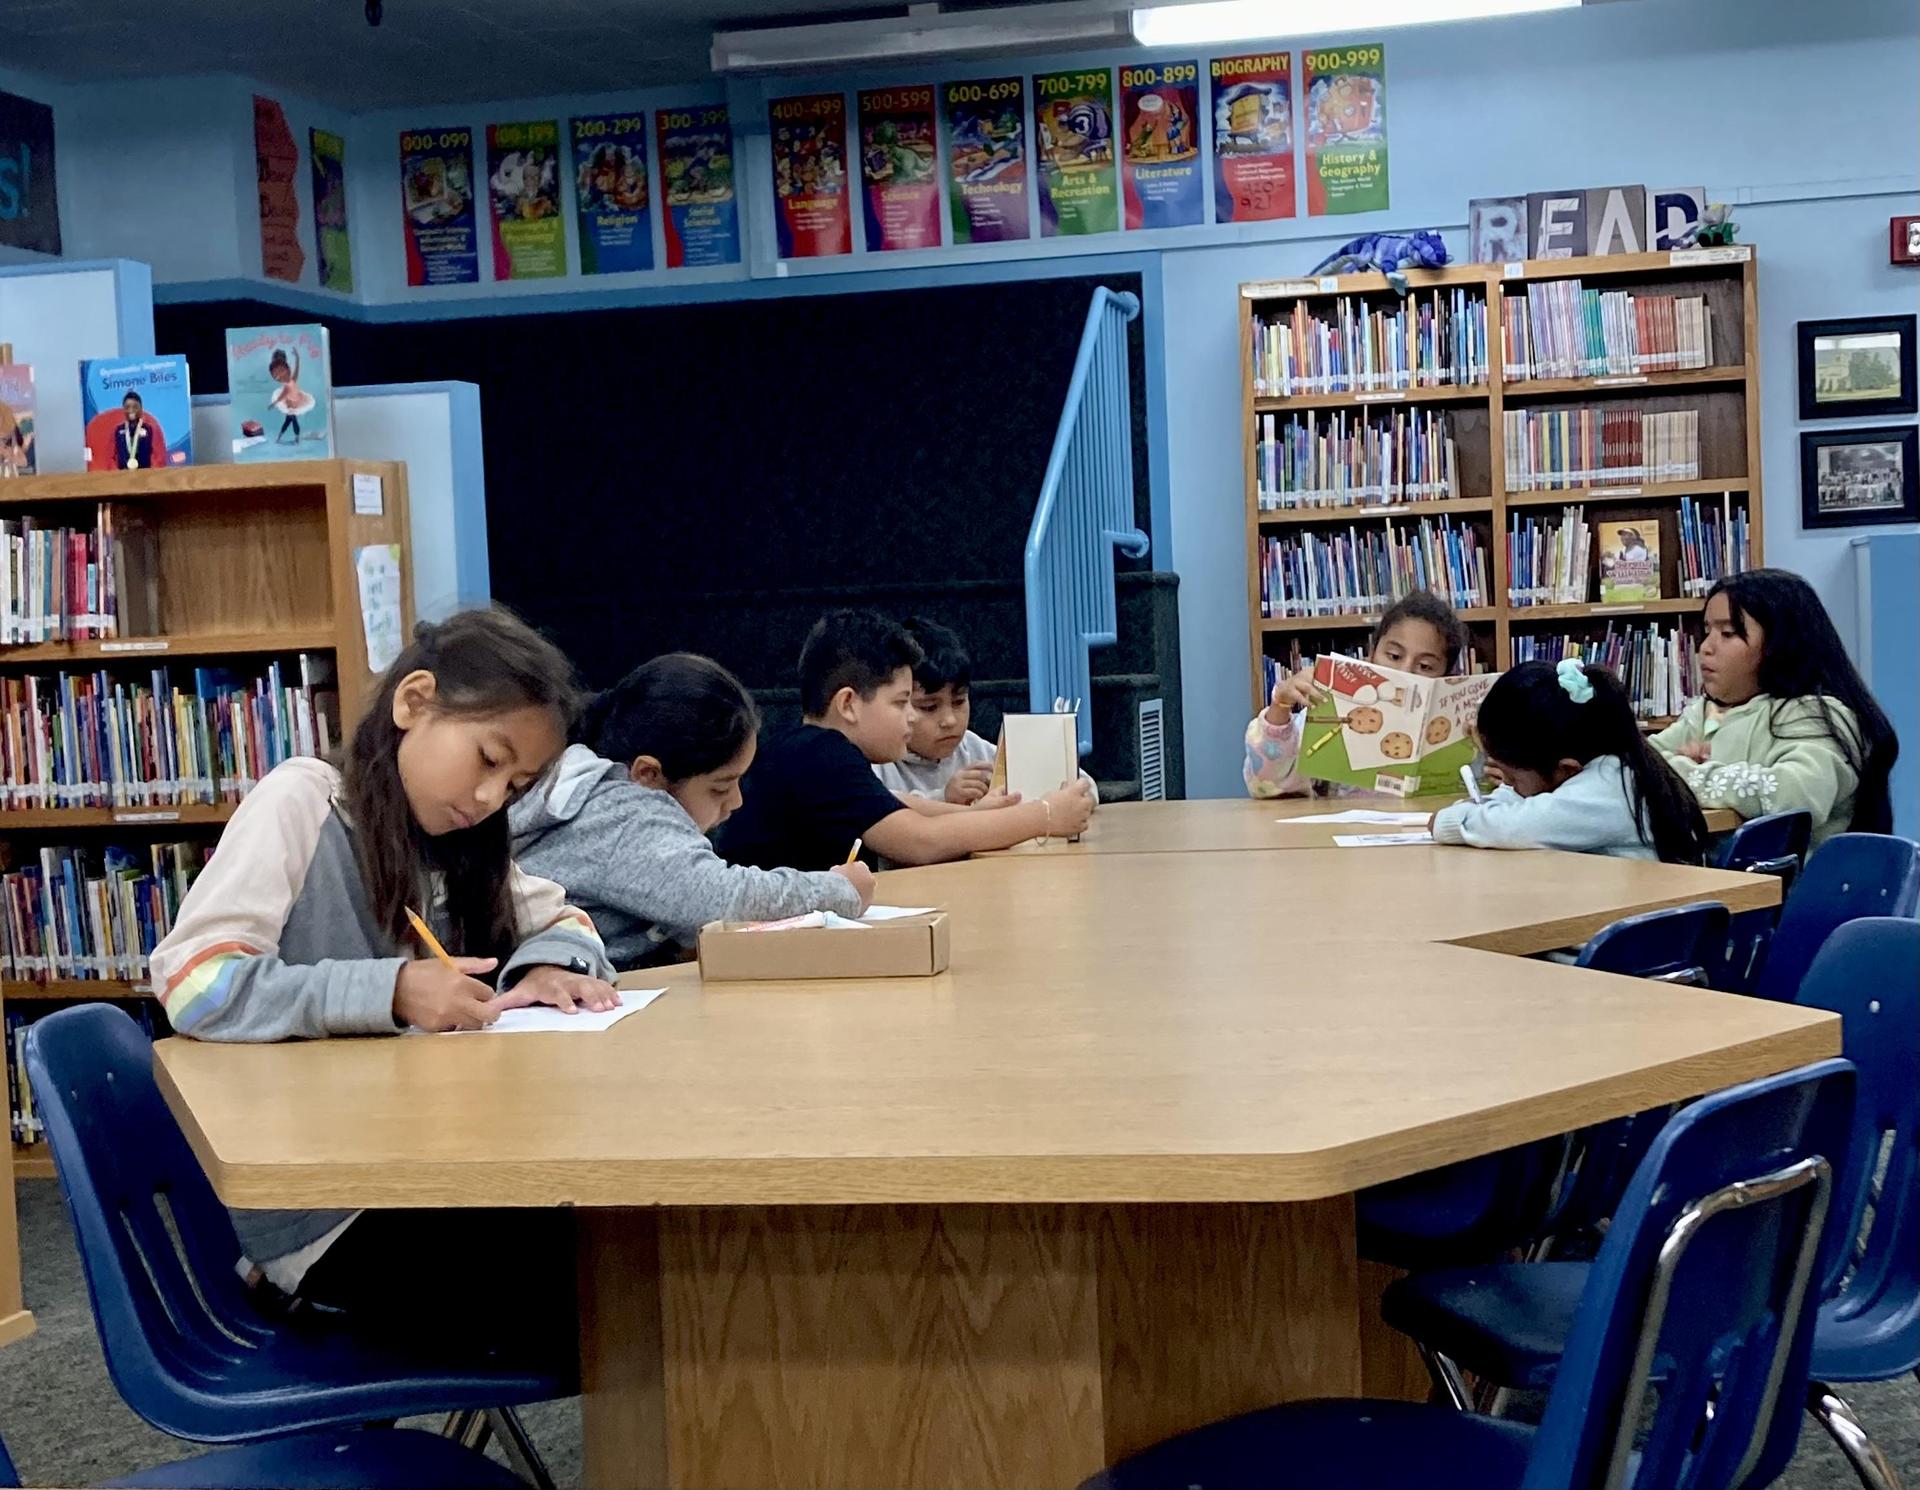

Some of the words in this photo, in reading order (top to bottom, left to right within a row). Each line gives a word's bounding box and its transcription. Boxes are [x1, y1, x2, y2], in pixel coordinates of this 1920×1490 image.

[1211, 57, 1289, 77] BIOGRAPHY
[1306, 48, 1380, 70] 900-999
[1038, 73, 1107, 95] 700-799
[1122, 65, 1196, 87] 800-899
[863, 91, 931, 112] 500-599
[949, 82, 1020, 103] 600-699
[773, 99, 841, 120] 400-499
[402, 132, 469, 151] 000-099
[1322, 153, 1365, 165] History
[1368, 149, 1377, 161] &
[1136, 167, 1192, 179] Literature
[1319, 162, 1381, 178] Geography
[962, 182, 1023, 197] Technology
[1062, 175, 1084, 187] Arts
[1050, 184, 1110, 200] Recreation
[1480, 189, 1700, 264] READ
[102, 376, 146, 391] Simone
[149, 371, 177, 384] Biles
[1439, 695, 1448, 710] IF
[1450, 687, 1466, 703] YOU
[1467, 678, 1489, 695] GIVE
